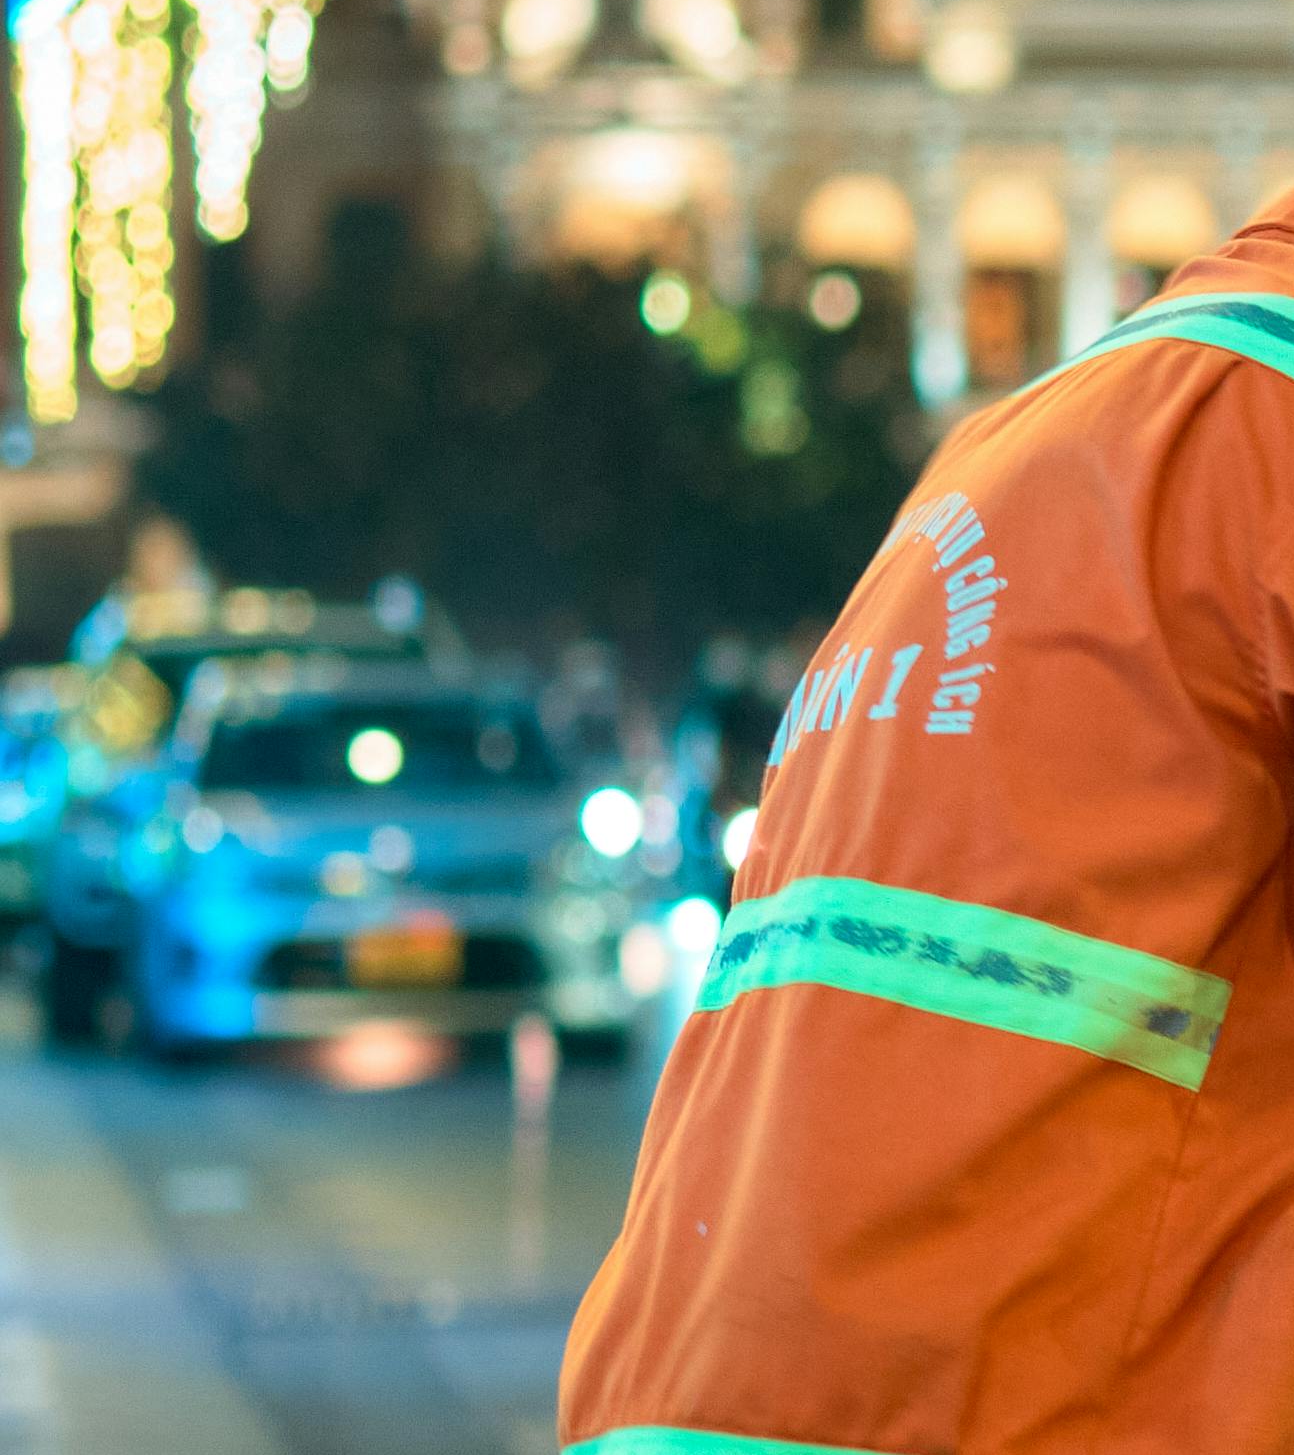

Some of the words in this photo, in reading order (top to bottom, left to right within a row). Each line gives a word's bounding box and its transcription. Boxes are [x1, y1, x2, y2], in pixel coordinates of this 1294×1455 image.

[943, 554, 1009, 662] CÔNG
[867, 642, 925, 722] 1
[924, 662, 997, 735] ÍCH
